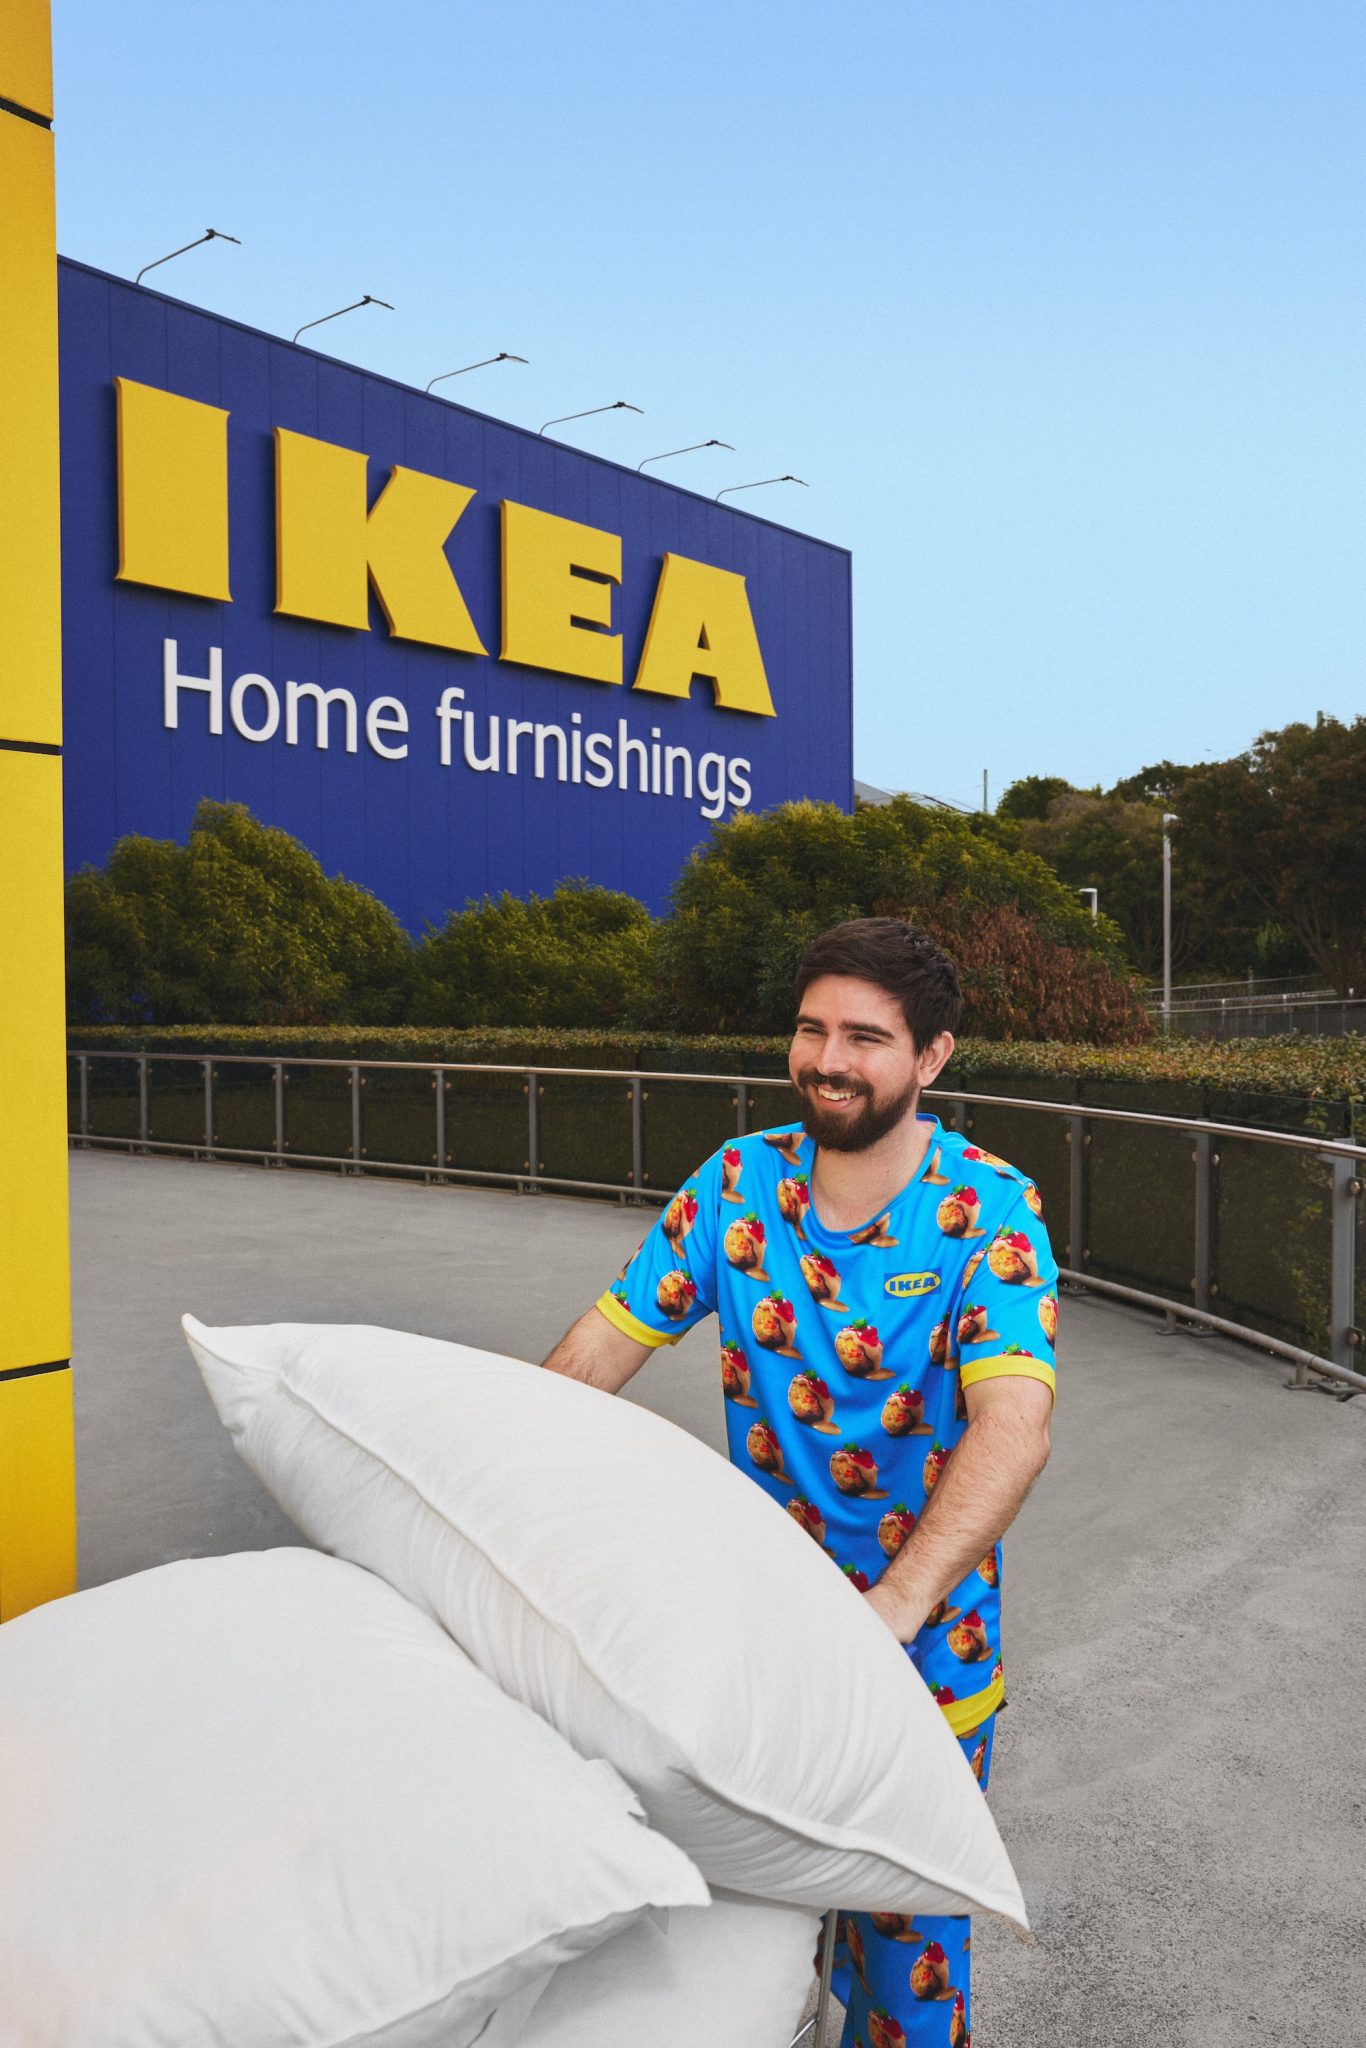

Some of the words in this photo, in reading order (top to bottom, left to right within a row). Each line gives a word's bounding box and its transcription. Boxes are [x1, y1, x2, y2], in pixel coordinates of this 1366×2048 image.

[114, 376, 777, 718] IKEA
[163, 638, 409, 761] Home
[435, 686, 753, 820] furnishings
[889, 1277, 936, 1291] IKEA
